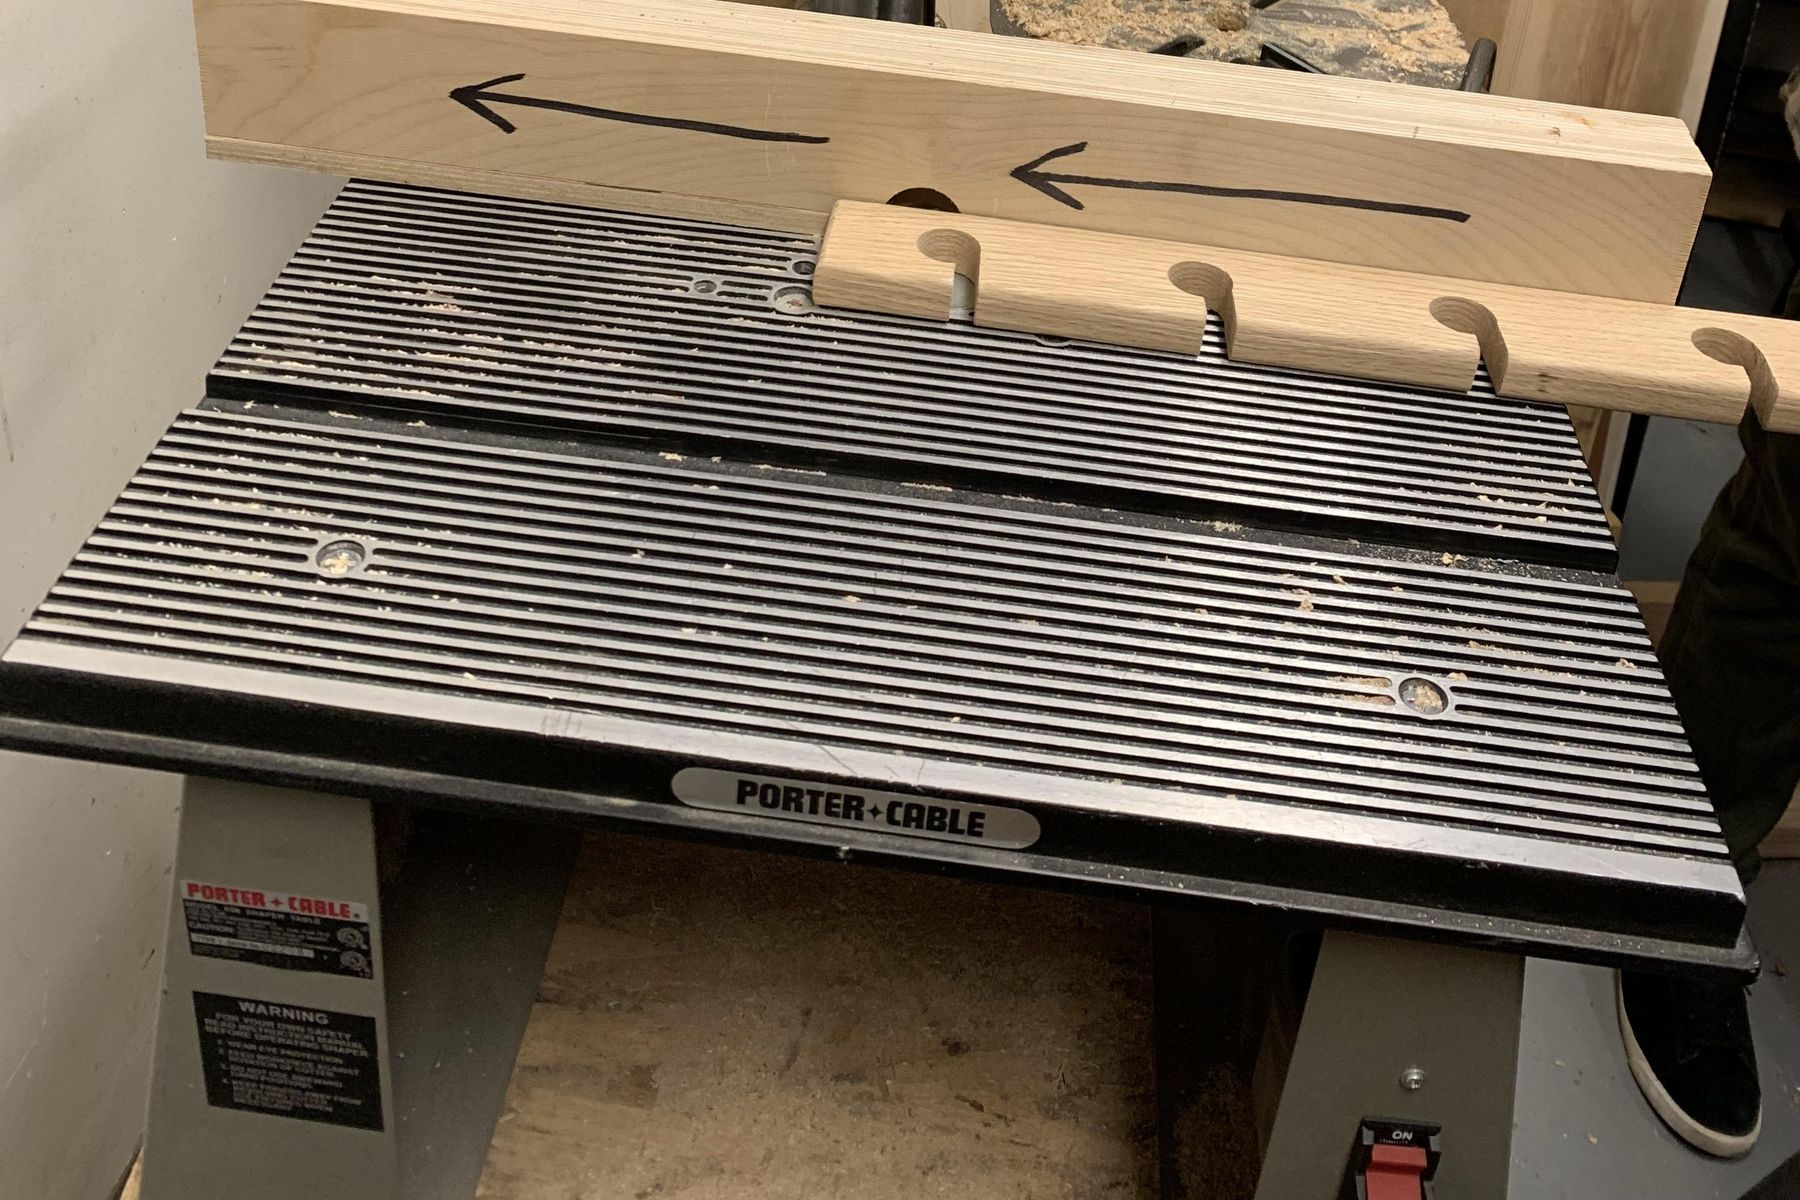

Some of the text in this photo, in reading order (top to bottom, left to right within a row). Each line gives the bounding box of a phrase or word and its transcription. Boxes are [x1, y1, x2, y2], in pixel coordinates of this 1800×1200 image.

[187, 883, 266, 907] PORTER
[238, 1000, 329, 1025] WARNING
[1392, 1131, 1413, 1141] ON
